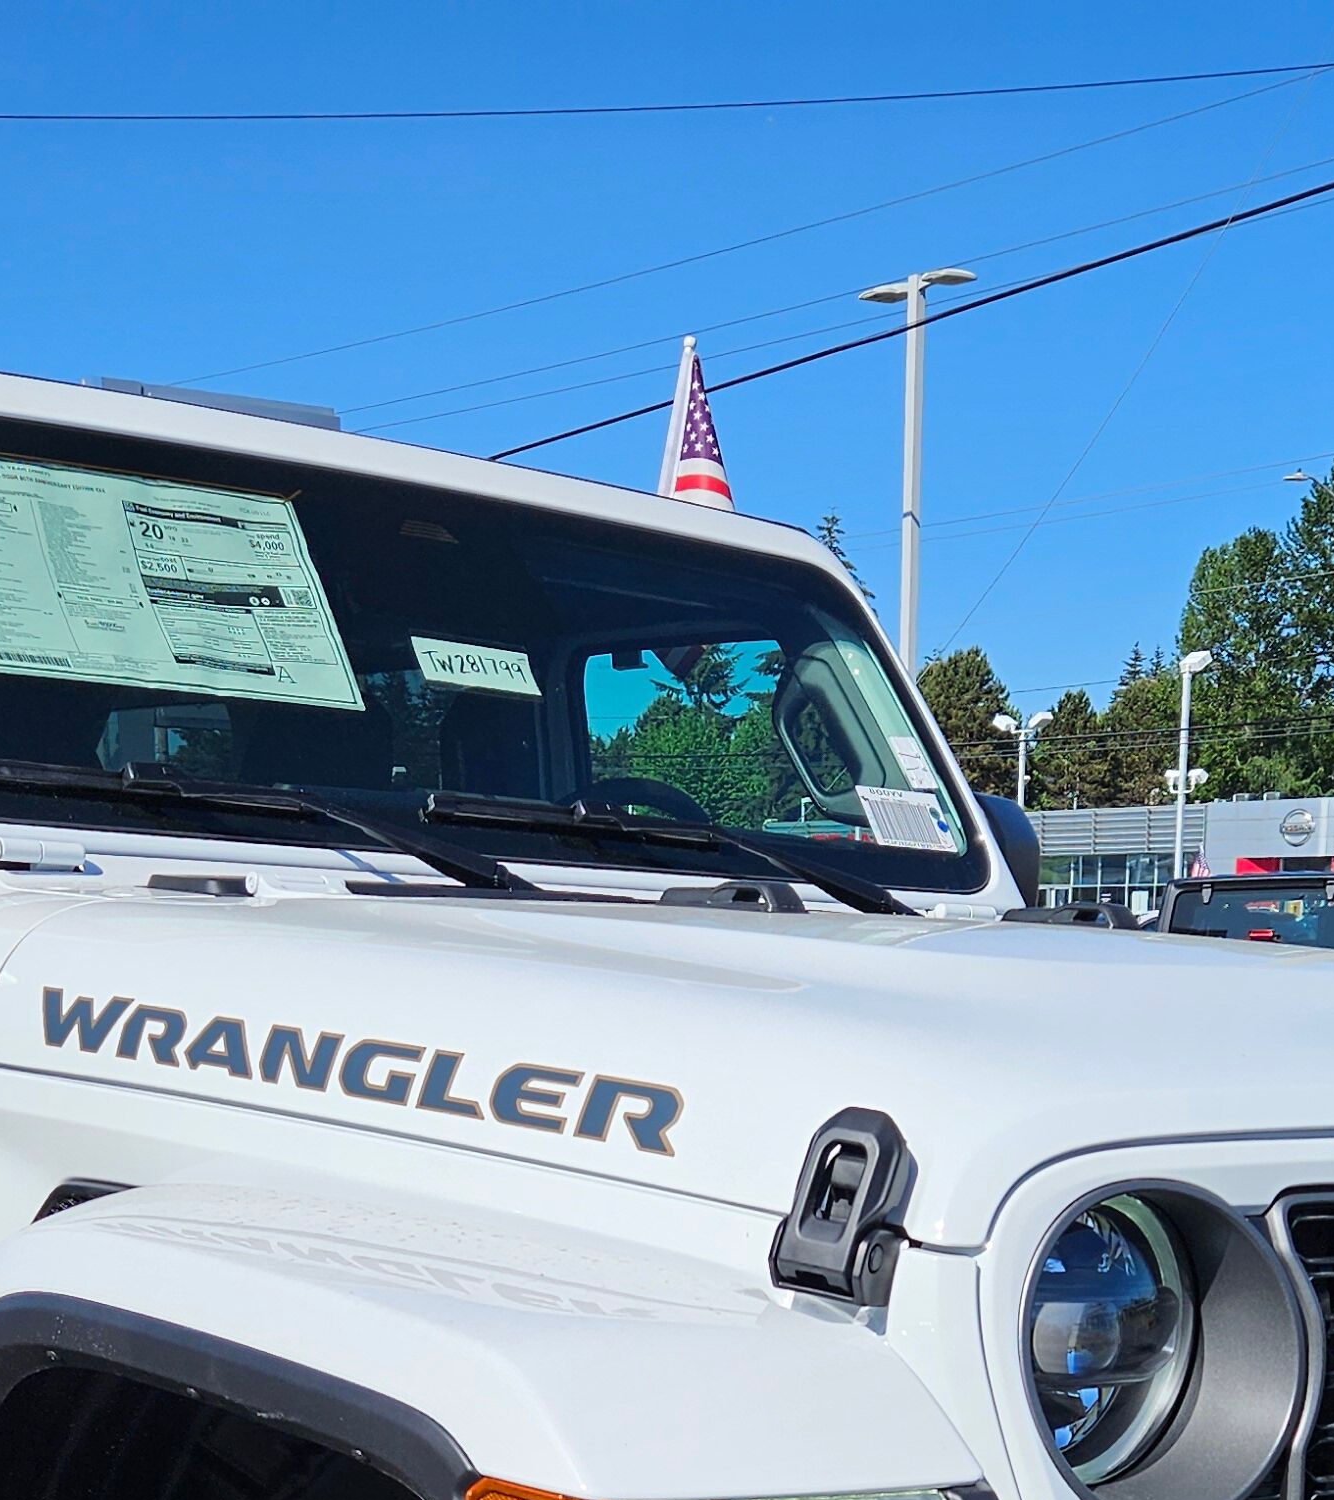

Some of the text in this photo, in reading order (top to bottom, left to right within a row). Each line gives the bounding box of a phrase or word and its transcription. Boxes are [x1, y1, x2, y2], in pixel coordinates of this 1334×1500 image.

[139, 520, 164, 540] 20
[249, 539, 285, 552] $4,000
[140, 560, 178, 574] $2,500
[42, 985, 685, 1158] WRANGLER
